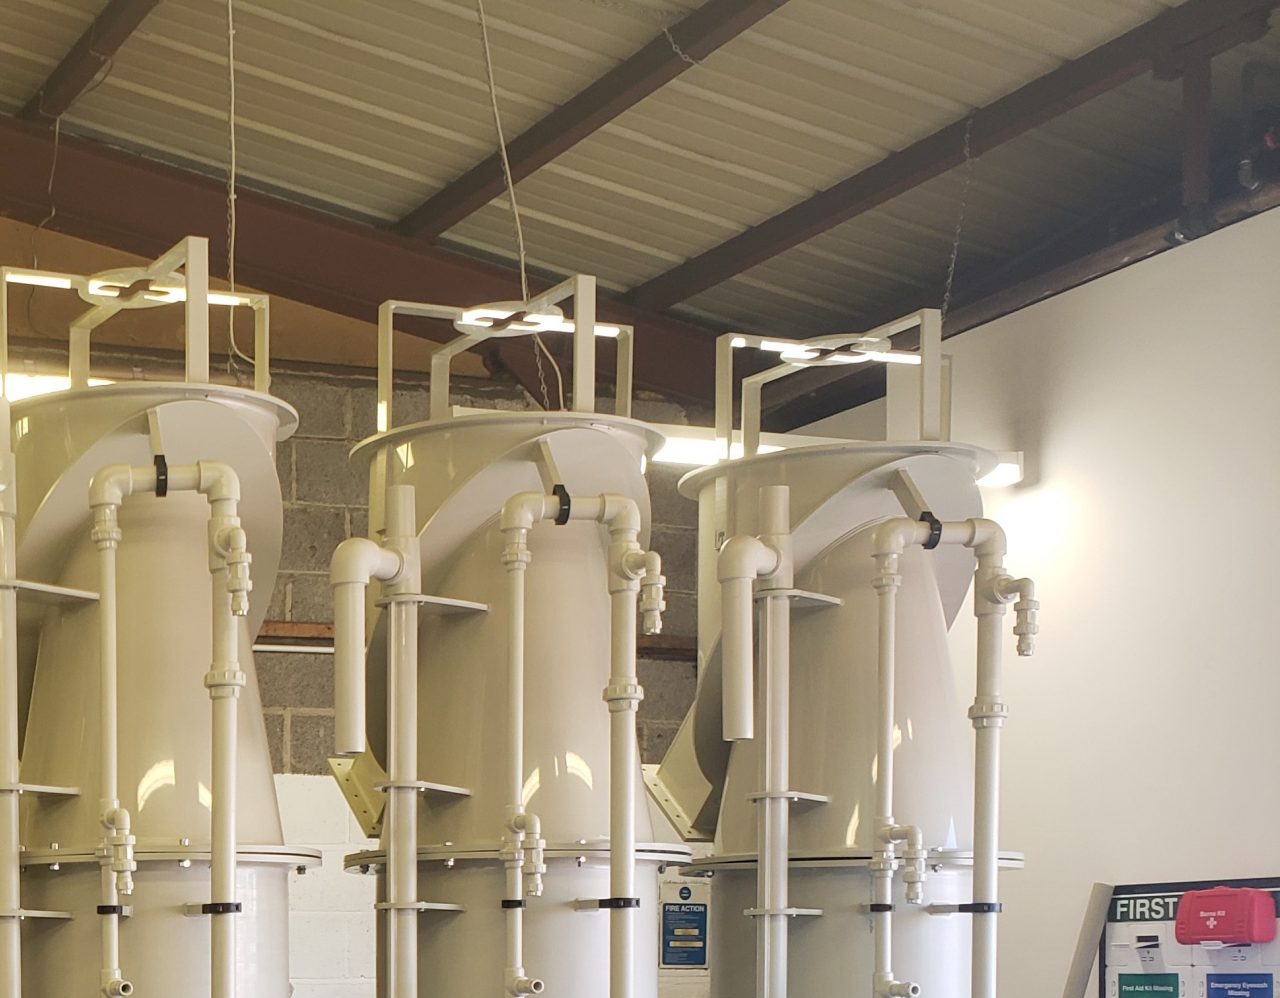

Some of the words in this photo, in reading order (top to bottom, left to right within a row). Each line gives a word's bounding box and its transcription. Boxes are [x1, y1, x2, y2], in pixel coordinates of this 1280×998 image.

[1116, 897, 1178, 920] FIRST
[1153, 985, 1174, 993] Missing
[1210, 982, 1241, 990] Emergency
[1227, 989, 1250, 998] Missing
